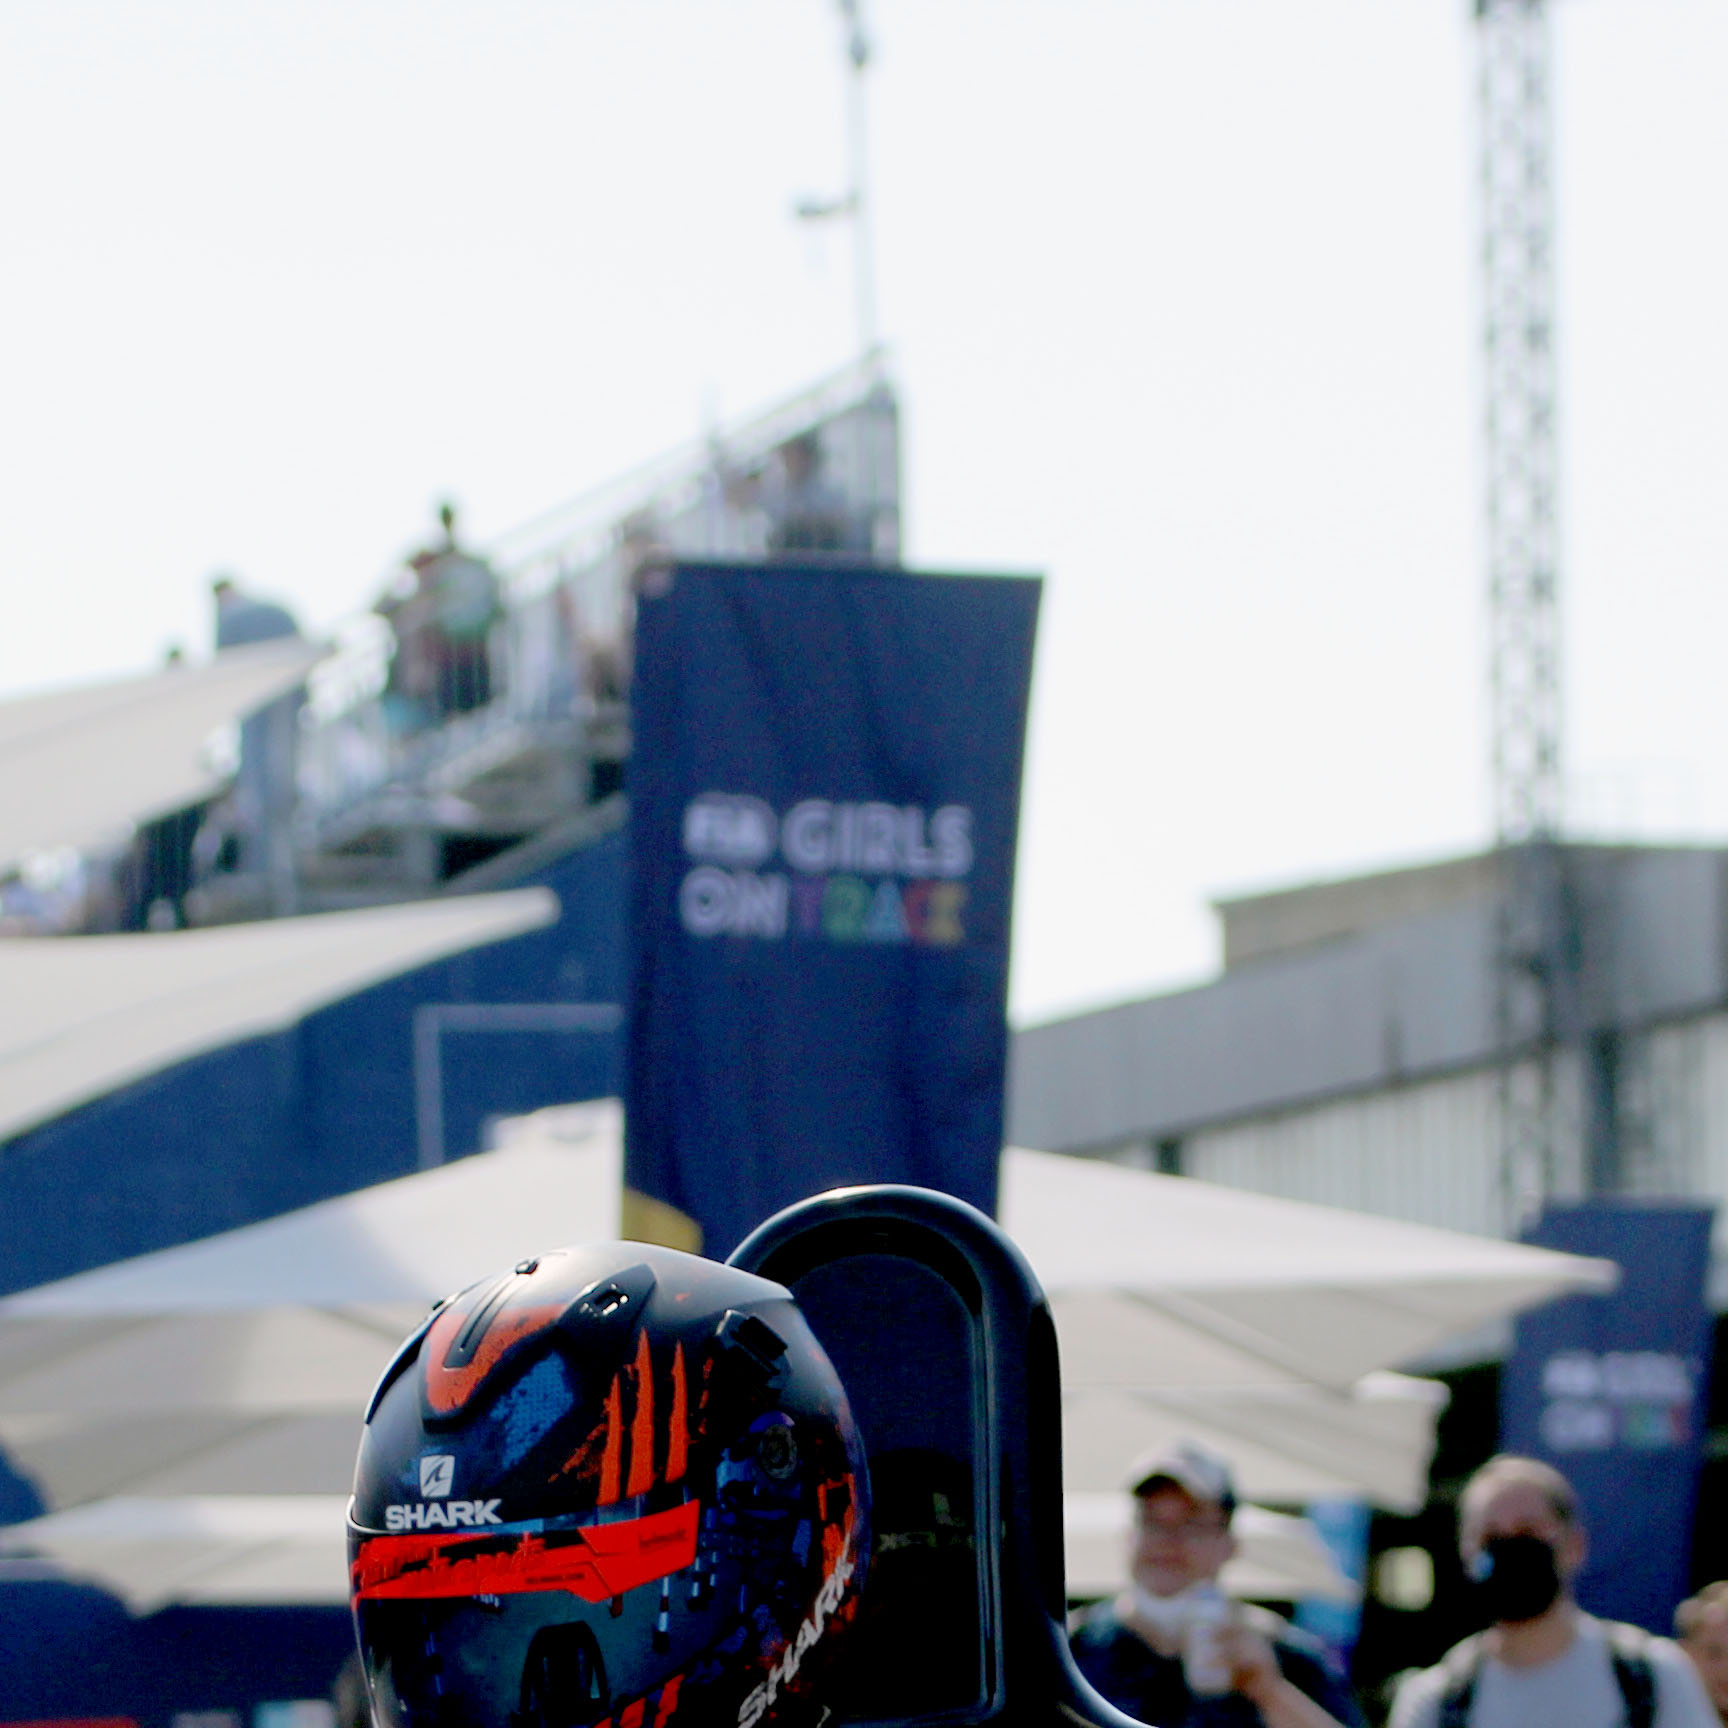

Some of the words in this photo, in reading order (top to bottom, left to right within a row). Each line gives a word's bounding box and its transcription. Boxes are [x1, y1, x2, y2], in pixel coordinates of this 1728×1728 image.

[783, 800, 973, 877] GIRLS
[681, 867, 789, 938] ON
[385, 1499, 503, 1530] SHARK
